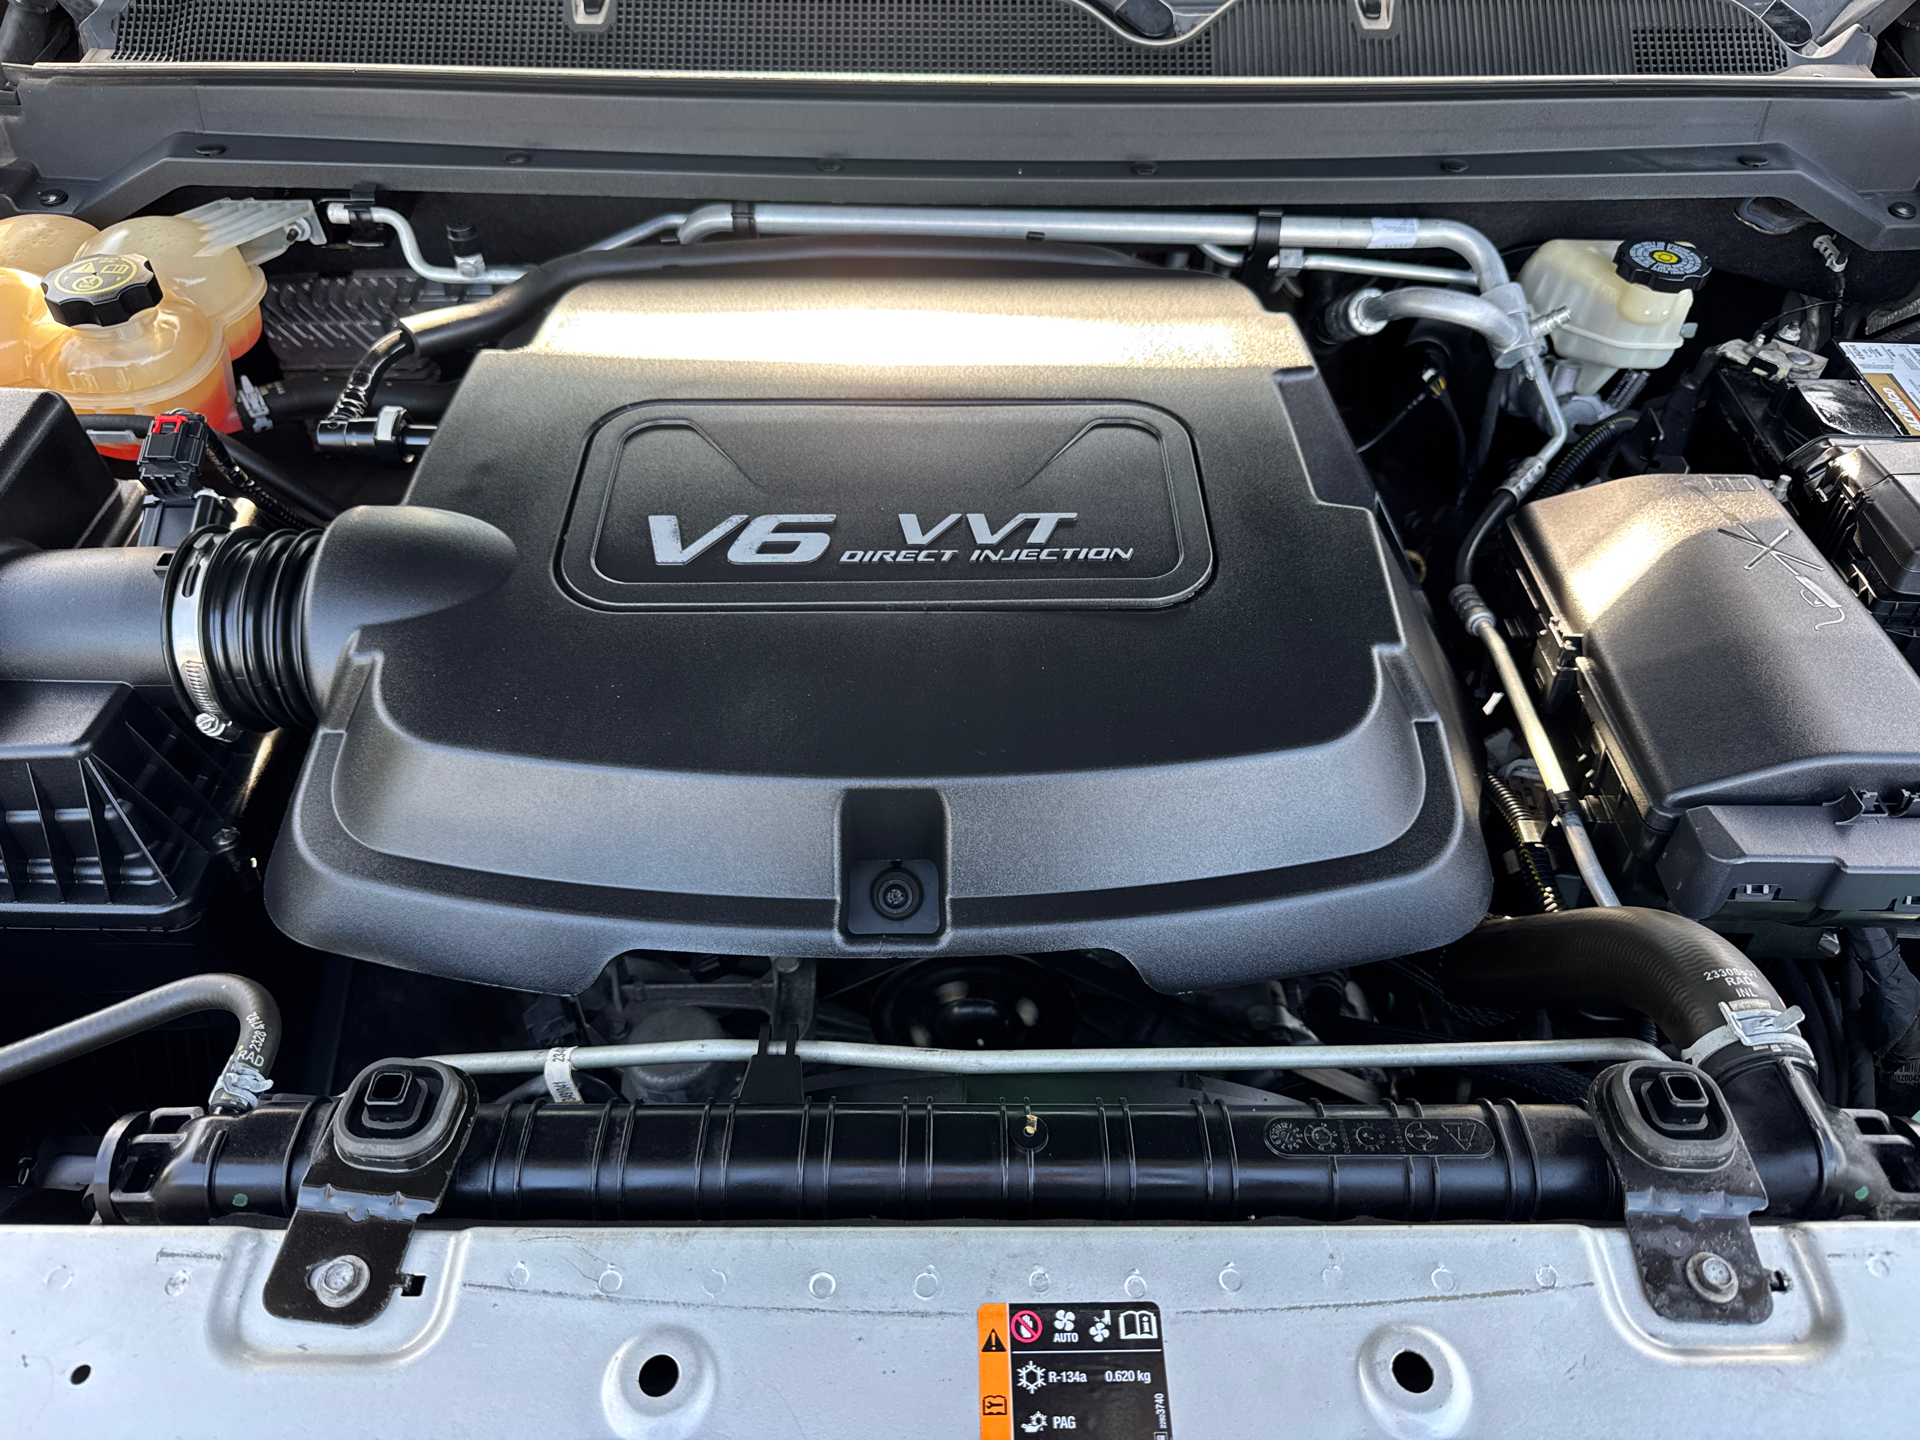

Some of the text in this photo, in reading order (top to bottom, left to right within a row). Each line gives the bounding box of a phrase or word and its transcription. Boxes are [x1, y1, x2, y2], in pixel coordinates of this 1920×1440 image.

[898, 512, 1078, 545] VVT
[648, 513, 837, 566] V6
[839, 546, 1135, 566] DIRECT INJECTION
[1724, 976, 1753, 987] RAD
[1735, 987, 1759, 998] INL
[237, 1050, 264, 1067] RAD
[1053, 1332, 1079, 1343] AUTO
[1049, 1370, 1151, 1384] R-134a 0.620 kg
[1053, 1416, 1077, 1429] PAG
